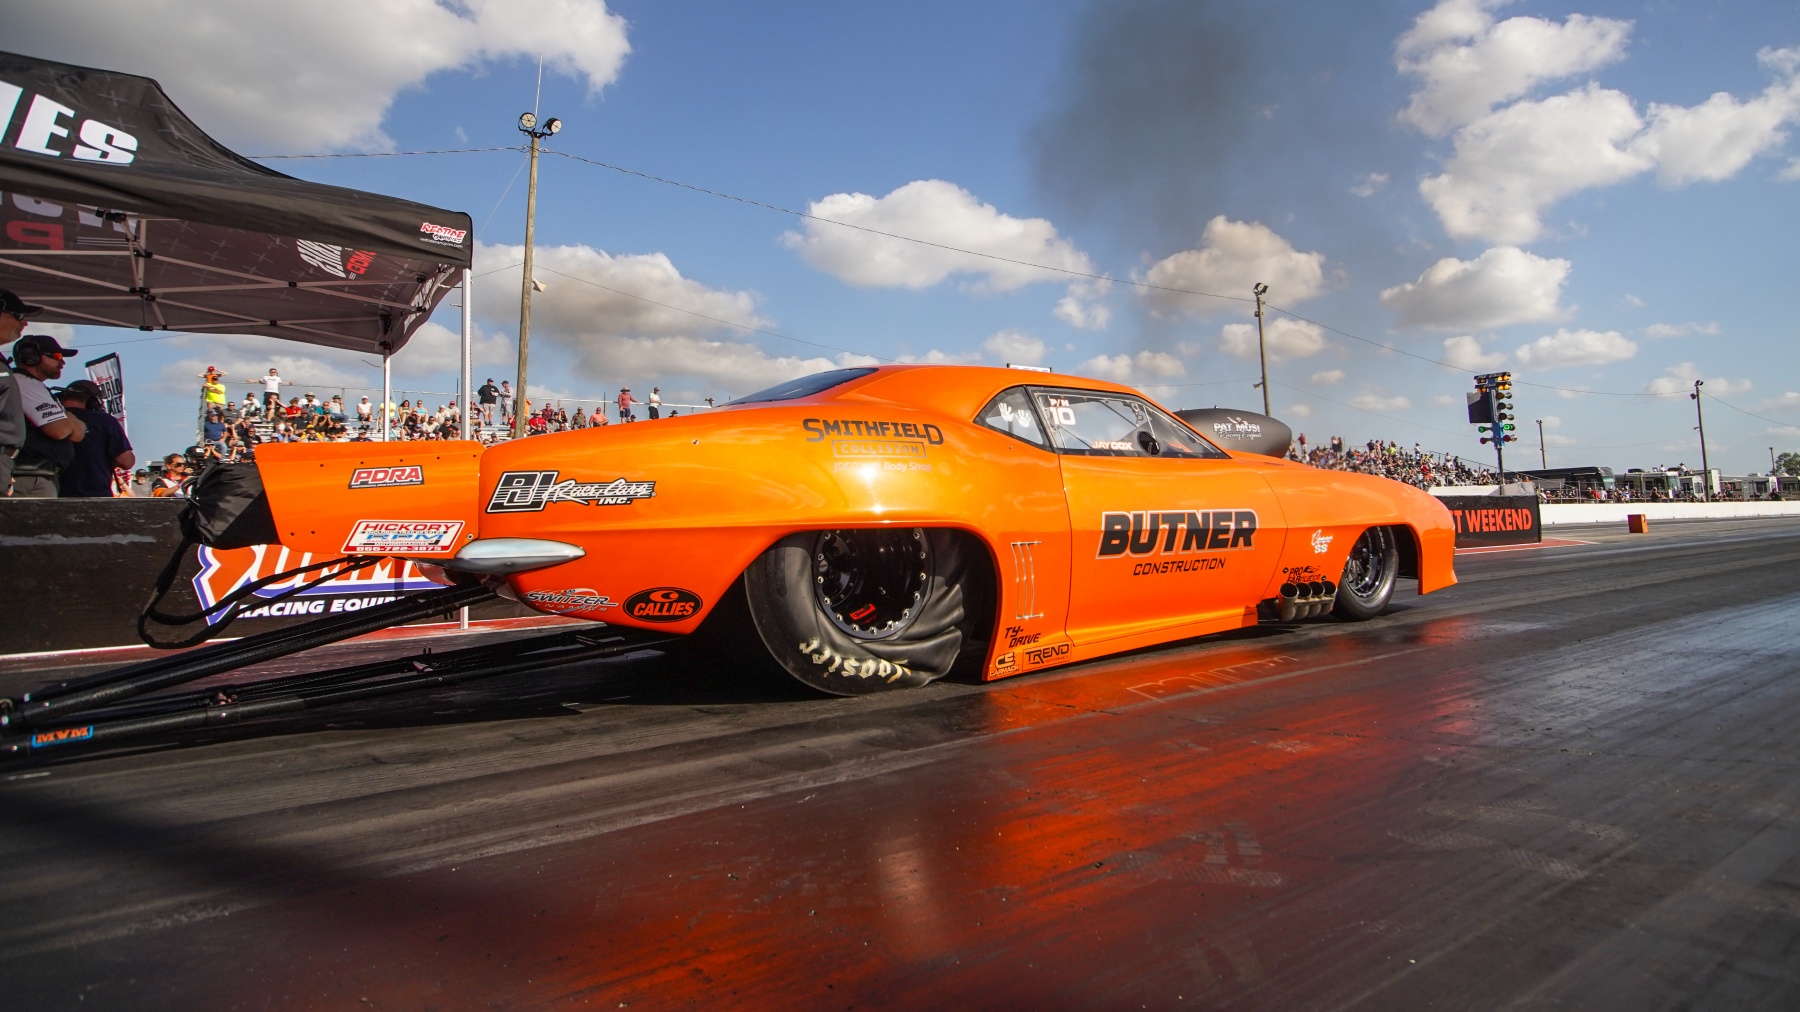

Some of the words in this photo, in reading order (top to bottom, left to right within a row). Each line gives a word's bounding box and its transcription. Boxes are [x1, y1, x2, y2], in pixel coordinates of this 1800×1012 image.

[1050, 407, 1076, 425] 10
[803, 418, 944, 445] SMITHFIELD
[1213, 423, 1232, 432] PAT
[841, 444, 920, 454] COLLISION
[1092, 441, 1111, 449] JAY
[1111, 442, 1133, 450] COX
[884, 462, 907, 472] Body
[909, 463, 933, 472] Shop
[351, 466, 422, 485] PDRA
[363, 523, 457, 531] HICKORY
[1449, 509, 1463, 534] T
[1465, 508, 1532, 533] WEEKEND
[1097, 510, 1258, 558] BUTNER
[1133, 558, 1226, 576] CONSTRUCTION
[526, 592, 619, 608] SWITZER
[633, 602, 695, 616] CALLIES
[1009, 633, 1041, 648] DRIVE
[1026, 644, 1070, 664] TREND
[990, 665, 1019, 677] CARMACK
[36, 728, 89, 744] MVM
